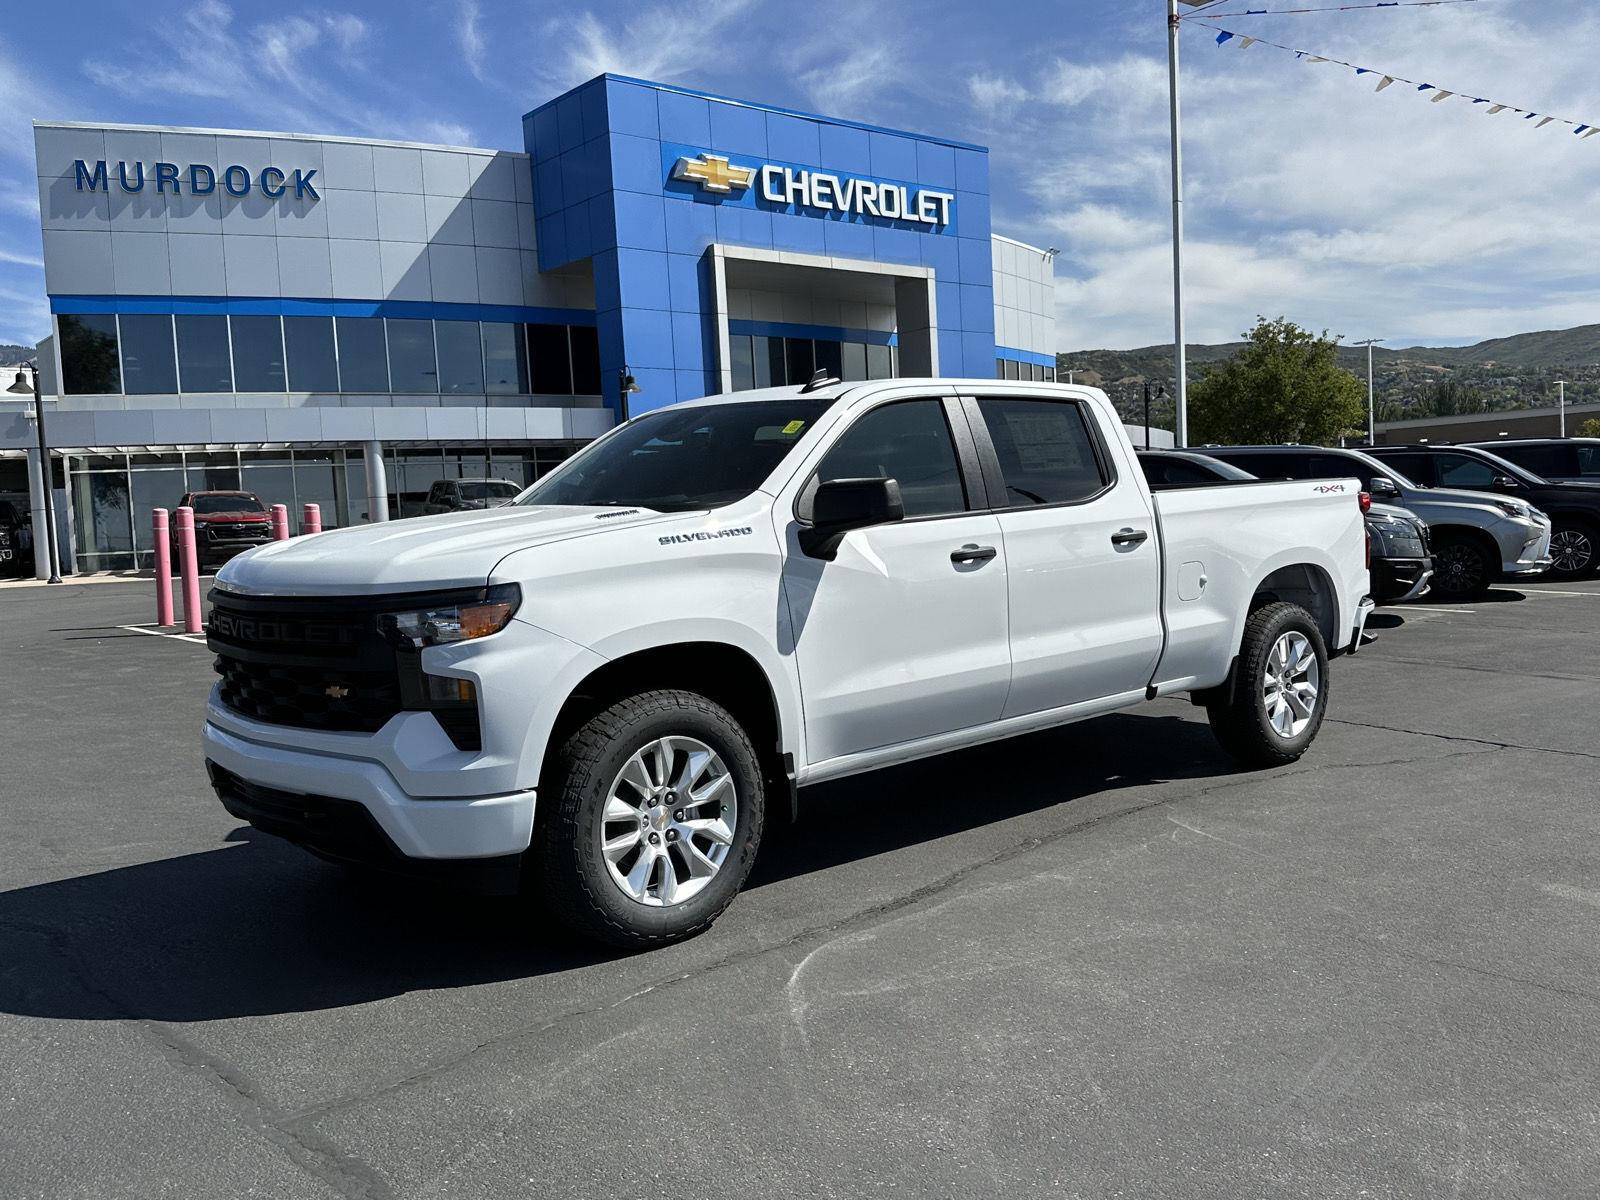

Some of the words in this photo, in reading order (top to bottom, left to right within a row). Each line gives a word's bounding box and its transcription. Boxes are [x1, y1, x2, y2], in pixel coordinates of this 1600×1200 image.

[74, 159, 320, 200] MURDOCK
[762, 164, 954, 225] CHEVROLET
[658, 526, 752, 545] SILVERADO
